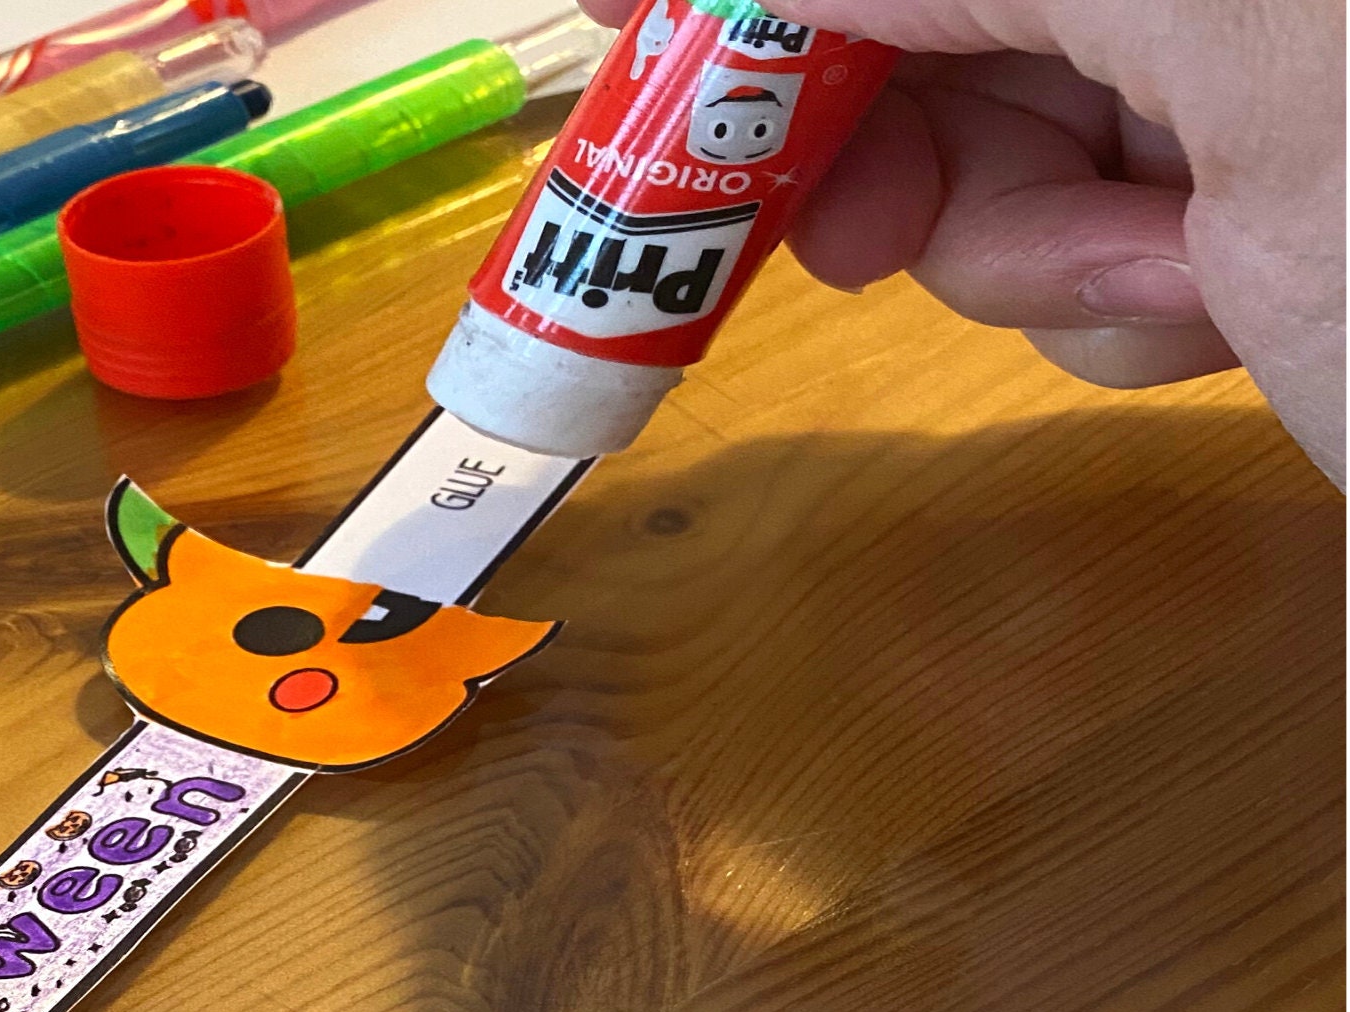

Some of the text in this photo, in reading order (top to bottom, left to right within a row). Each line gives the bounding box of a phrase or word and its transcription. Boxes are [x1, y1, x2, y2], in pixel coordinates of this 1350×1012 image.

[574, 137, 751, 195] ORIGINAL
[523, 221, 726, 315] Pritt
[430, 458, 506, 510] GLUE
